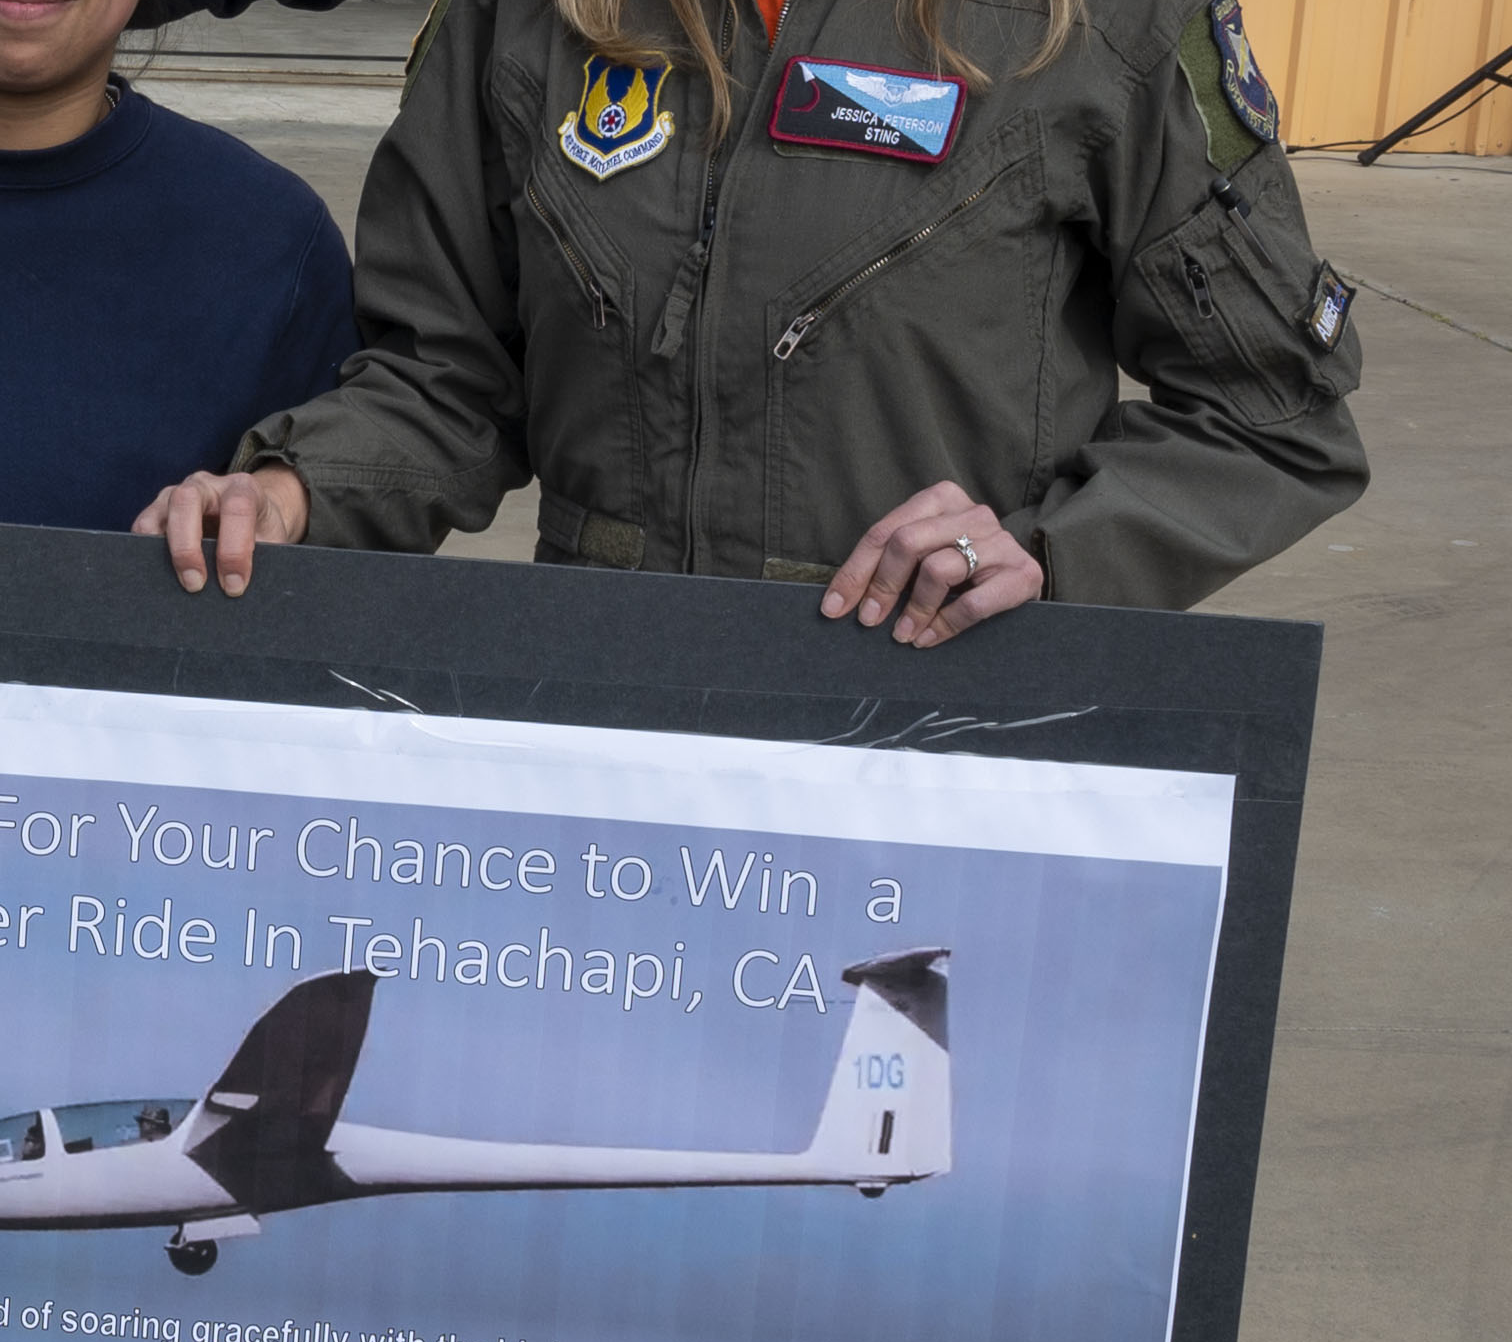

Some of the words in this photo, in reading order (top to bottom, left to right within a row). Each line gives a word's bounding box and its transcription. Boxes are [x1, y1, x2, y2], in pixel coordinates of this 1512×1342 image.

[830, 106, 879, 126] JESSICA
[882, 114, 945, 136] PETERSON
[864, 126, 901, 146] STING
[622, 131, 666, 163] COMMAND
[116, 801, 276, 872] Your
[295, 816, 557, 895] Chance
[579, 842, 654, 902] to
[679, 845, 819, 918] Win
[865, 877, 903, 925] a
[67, 893, 218, 964] Ride
[244, 907, 302, 971] In
[327, 915, 704, 1015] Tehachapi,
[732, 948, 828, 1015] CA
[852, 1052, 906, 1091] 1DG
[19, 1299, 56, 1332] of
